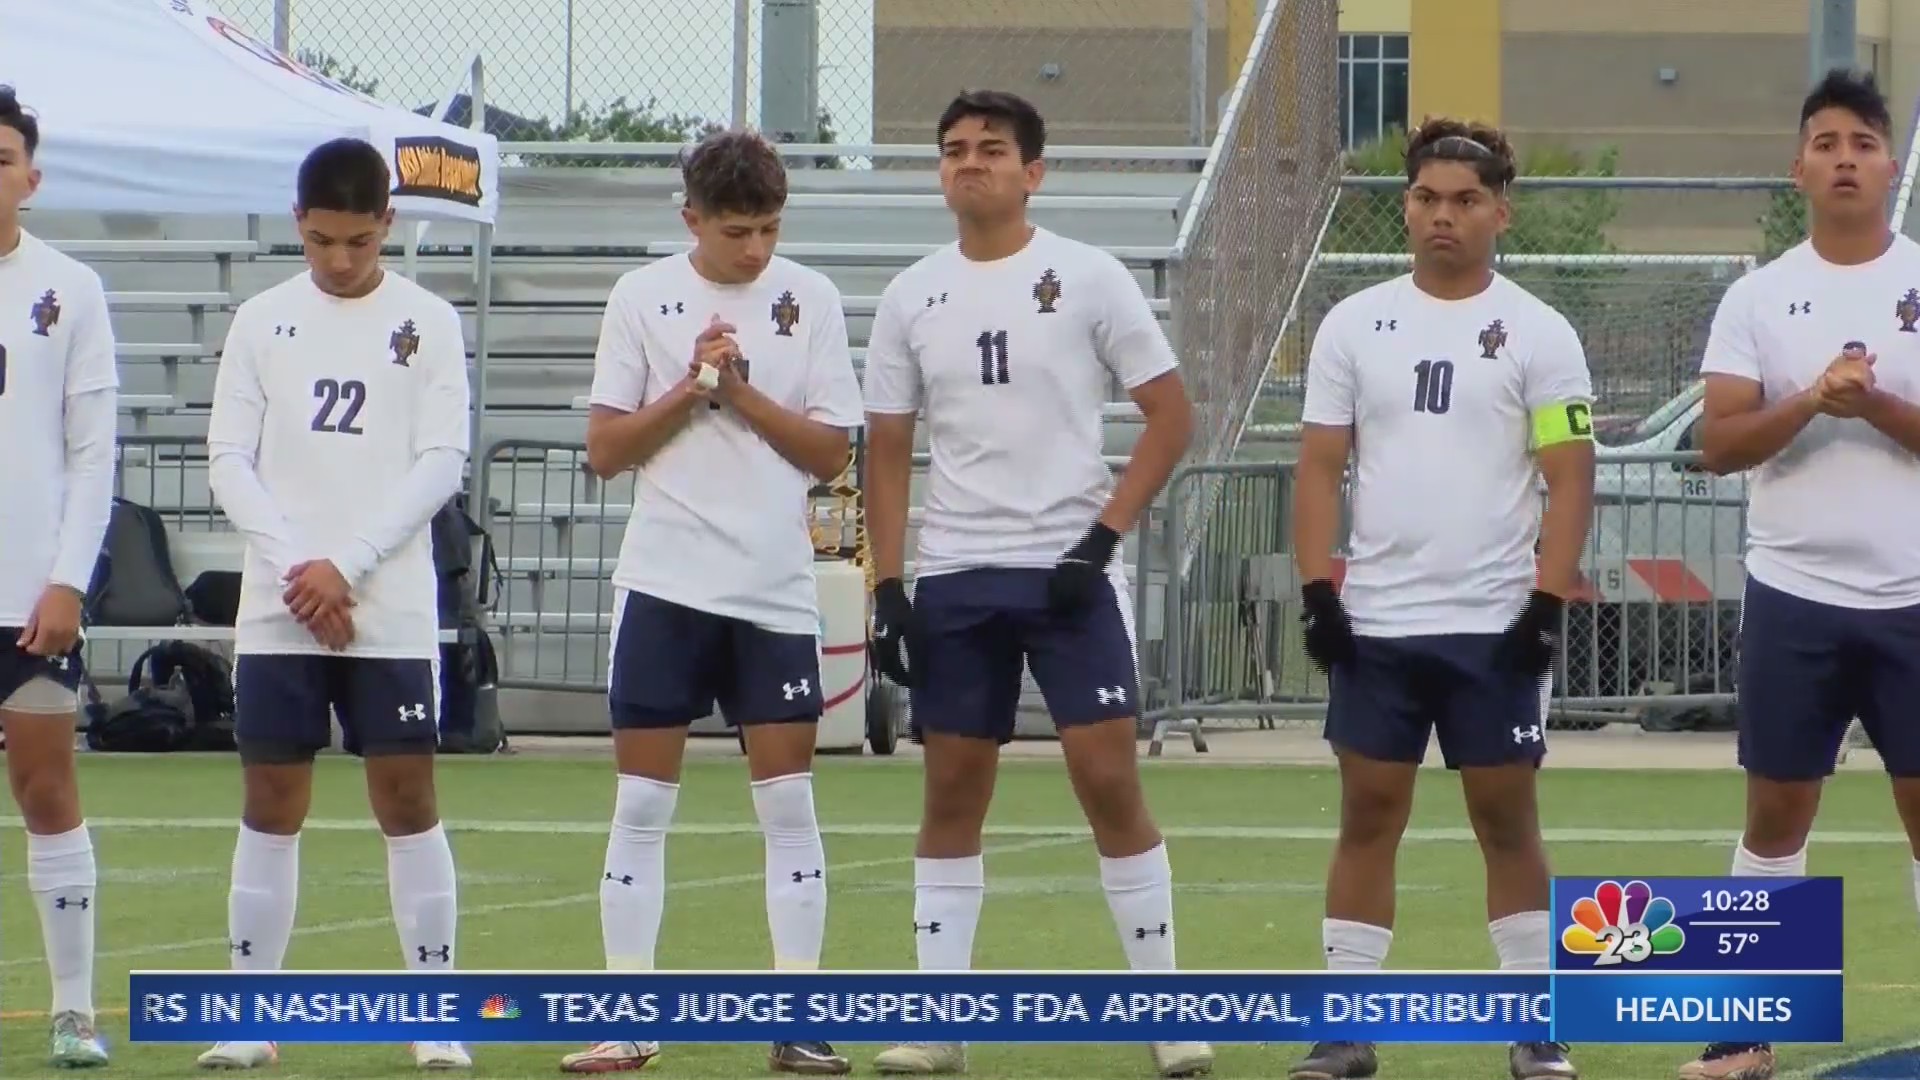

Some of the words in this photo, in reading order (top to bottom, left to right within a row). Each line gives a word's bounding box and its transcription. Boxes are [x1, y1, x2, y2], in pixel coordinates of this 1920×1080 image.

[976, 330, 1010, 385] 11
[311, 378, 366, 435] 22
[1414, 360, 1454, 414] 10
[1566, 404, 1591, 435] C
